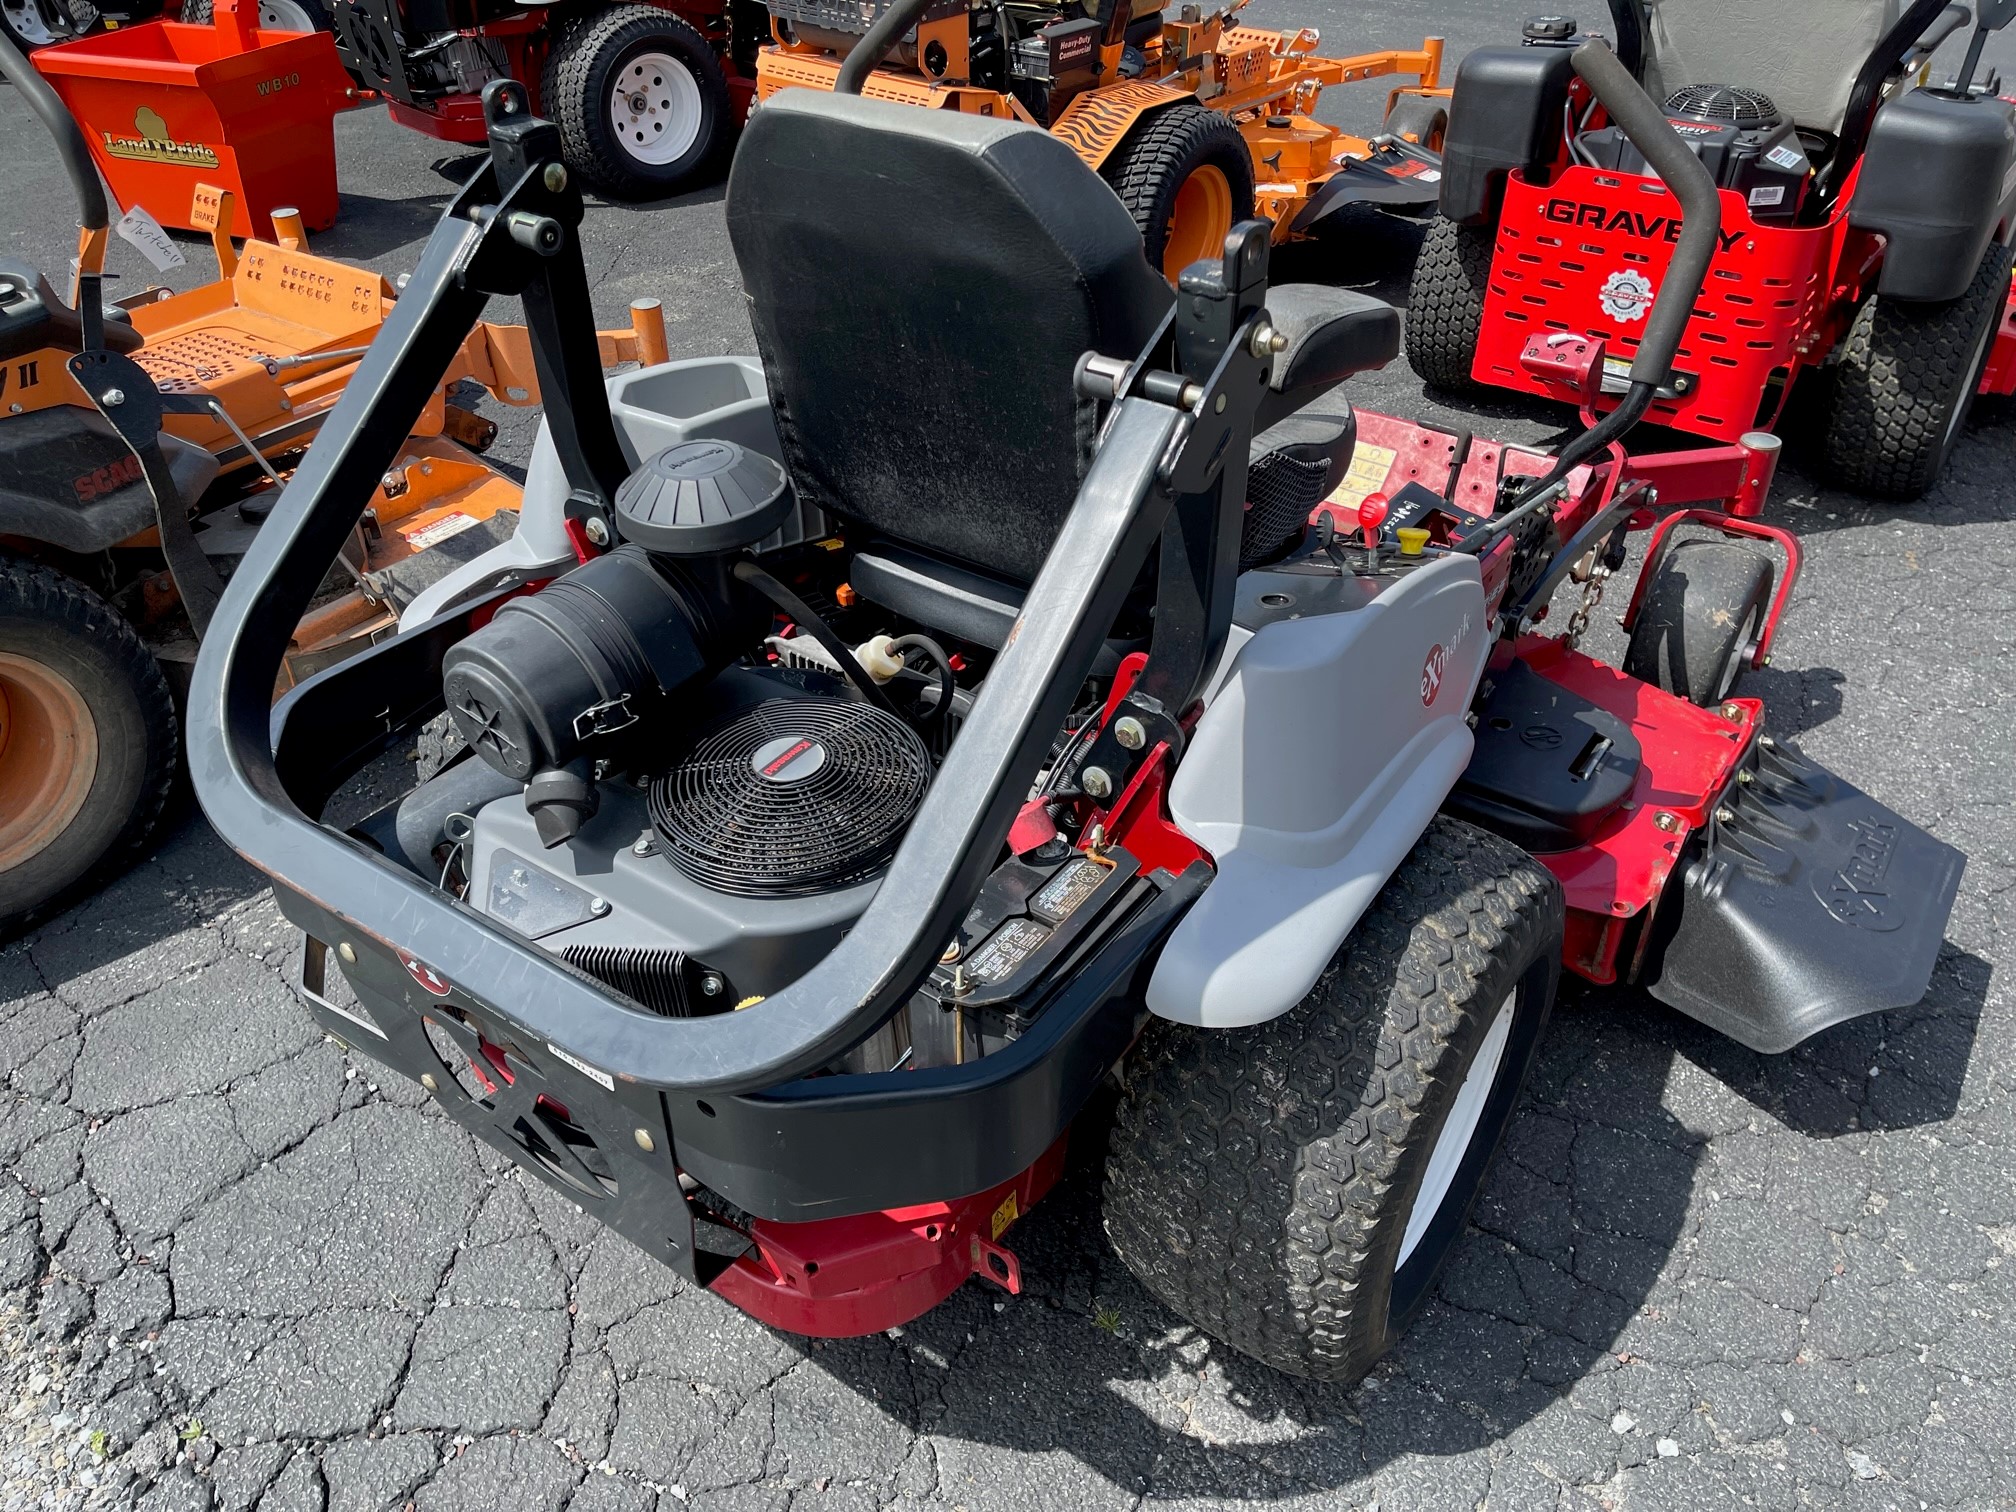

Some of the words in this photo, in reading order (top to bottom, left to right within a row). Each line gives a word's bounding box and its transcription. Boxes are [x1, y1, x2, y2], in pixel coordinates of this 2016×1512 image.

[1059, 44, 1092, 60] Commercial
[1060, 35, 1091, 50] Heavy-Duty
[256, 72, 300, 96] WB10
[103, 131, 151, 154] Land
[162, 138, 218, 163] Pride
[194, 209, 215, 224] BRAKE
[1545, 198, 1746, 254] GRAVEY
[420, 514, 458, 532] DANGER
[763, 740, 812, 776] Kawasaki
[974, 942, 998, 965] DANGER
[998, 922, 1019, 941] POISON
